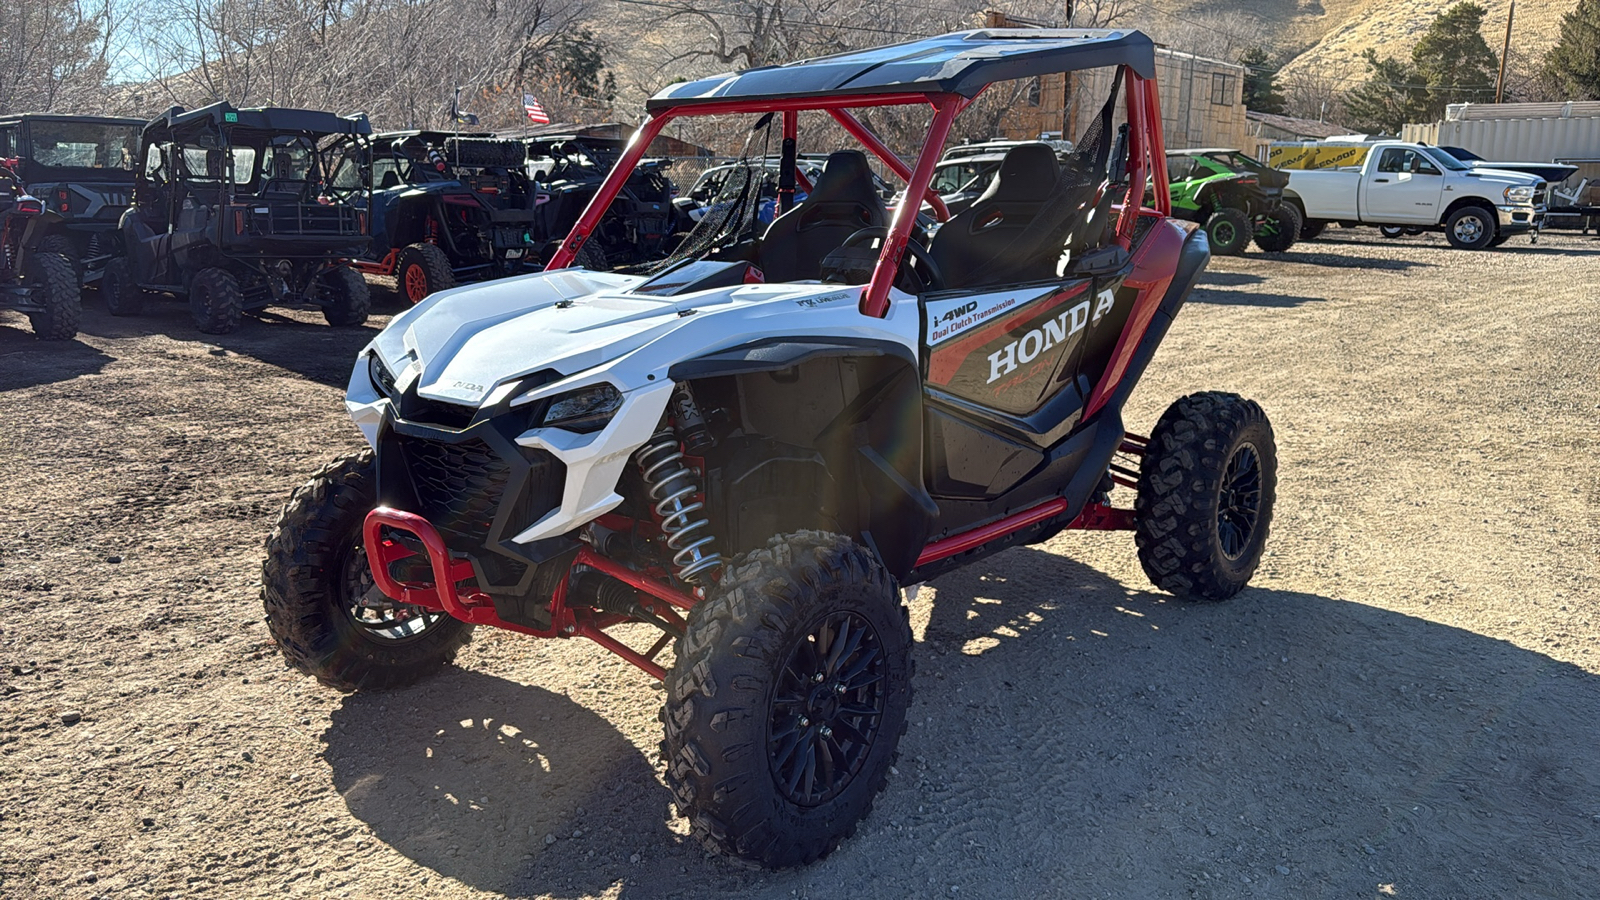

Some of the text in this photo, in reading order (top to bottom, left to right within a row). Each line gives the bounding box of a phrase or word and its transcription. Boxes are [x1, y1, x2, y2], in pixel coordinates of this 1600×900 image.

[932, 298, 1016, 341] Dual Clutch Transmission
[933, 301, 978, 328] i-4WD
[986, 288, 1115, 385] HONDA
